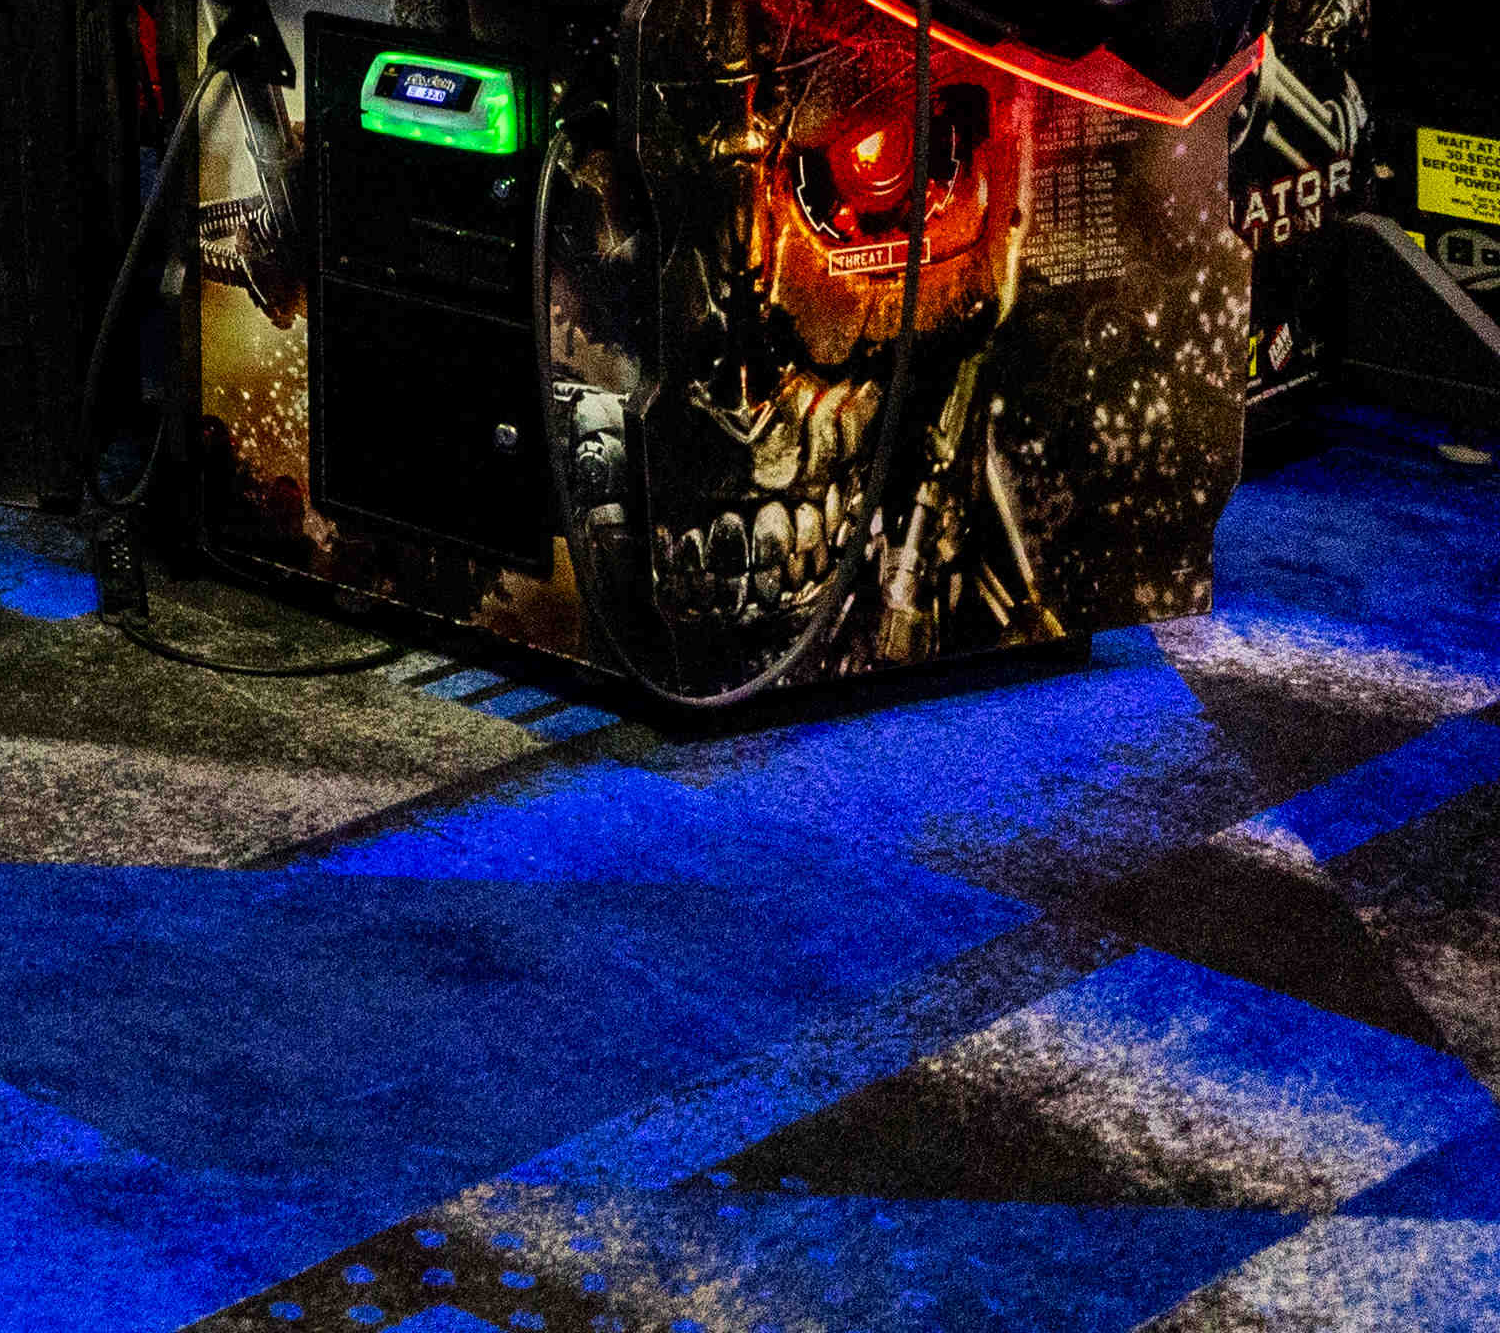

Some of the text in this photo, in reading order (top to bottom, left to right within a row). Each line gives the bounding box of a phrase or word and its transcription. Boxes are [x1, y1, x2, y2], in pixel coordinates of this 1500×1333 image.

[1437, 135, 1493, 153] WAIT AT
[1446, 149, 1462, 160] 30
[1422, 157, 1478, 176] BEFORE
[1230, 158, 1352, 231] ATOR
[839, 249, 883, 268] THREAT
